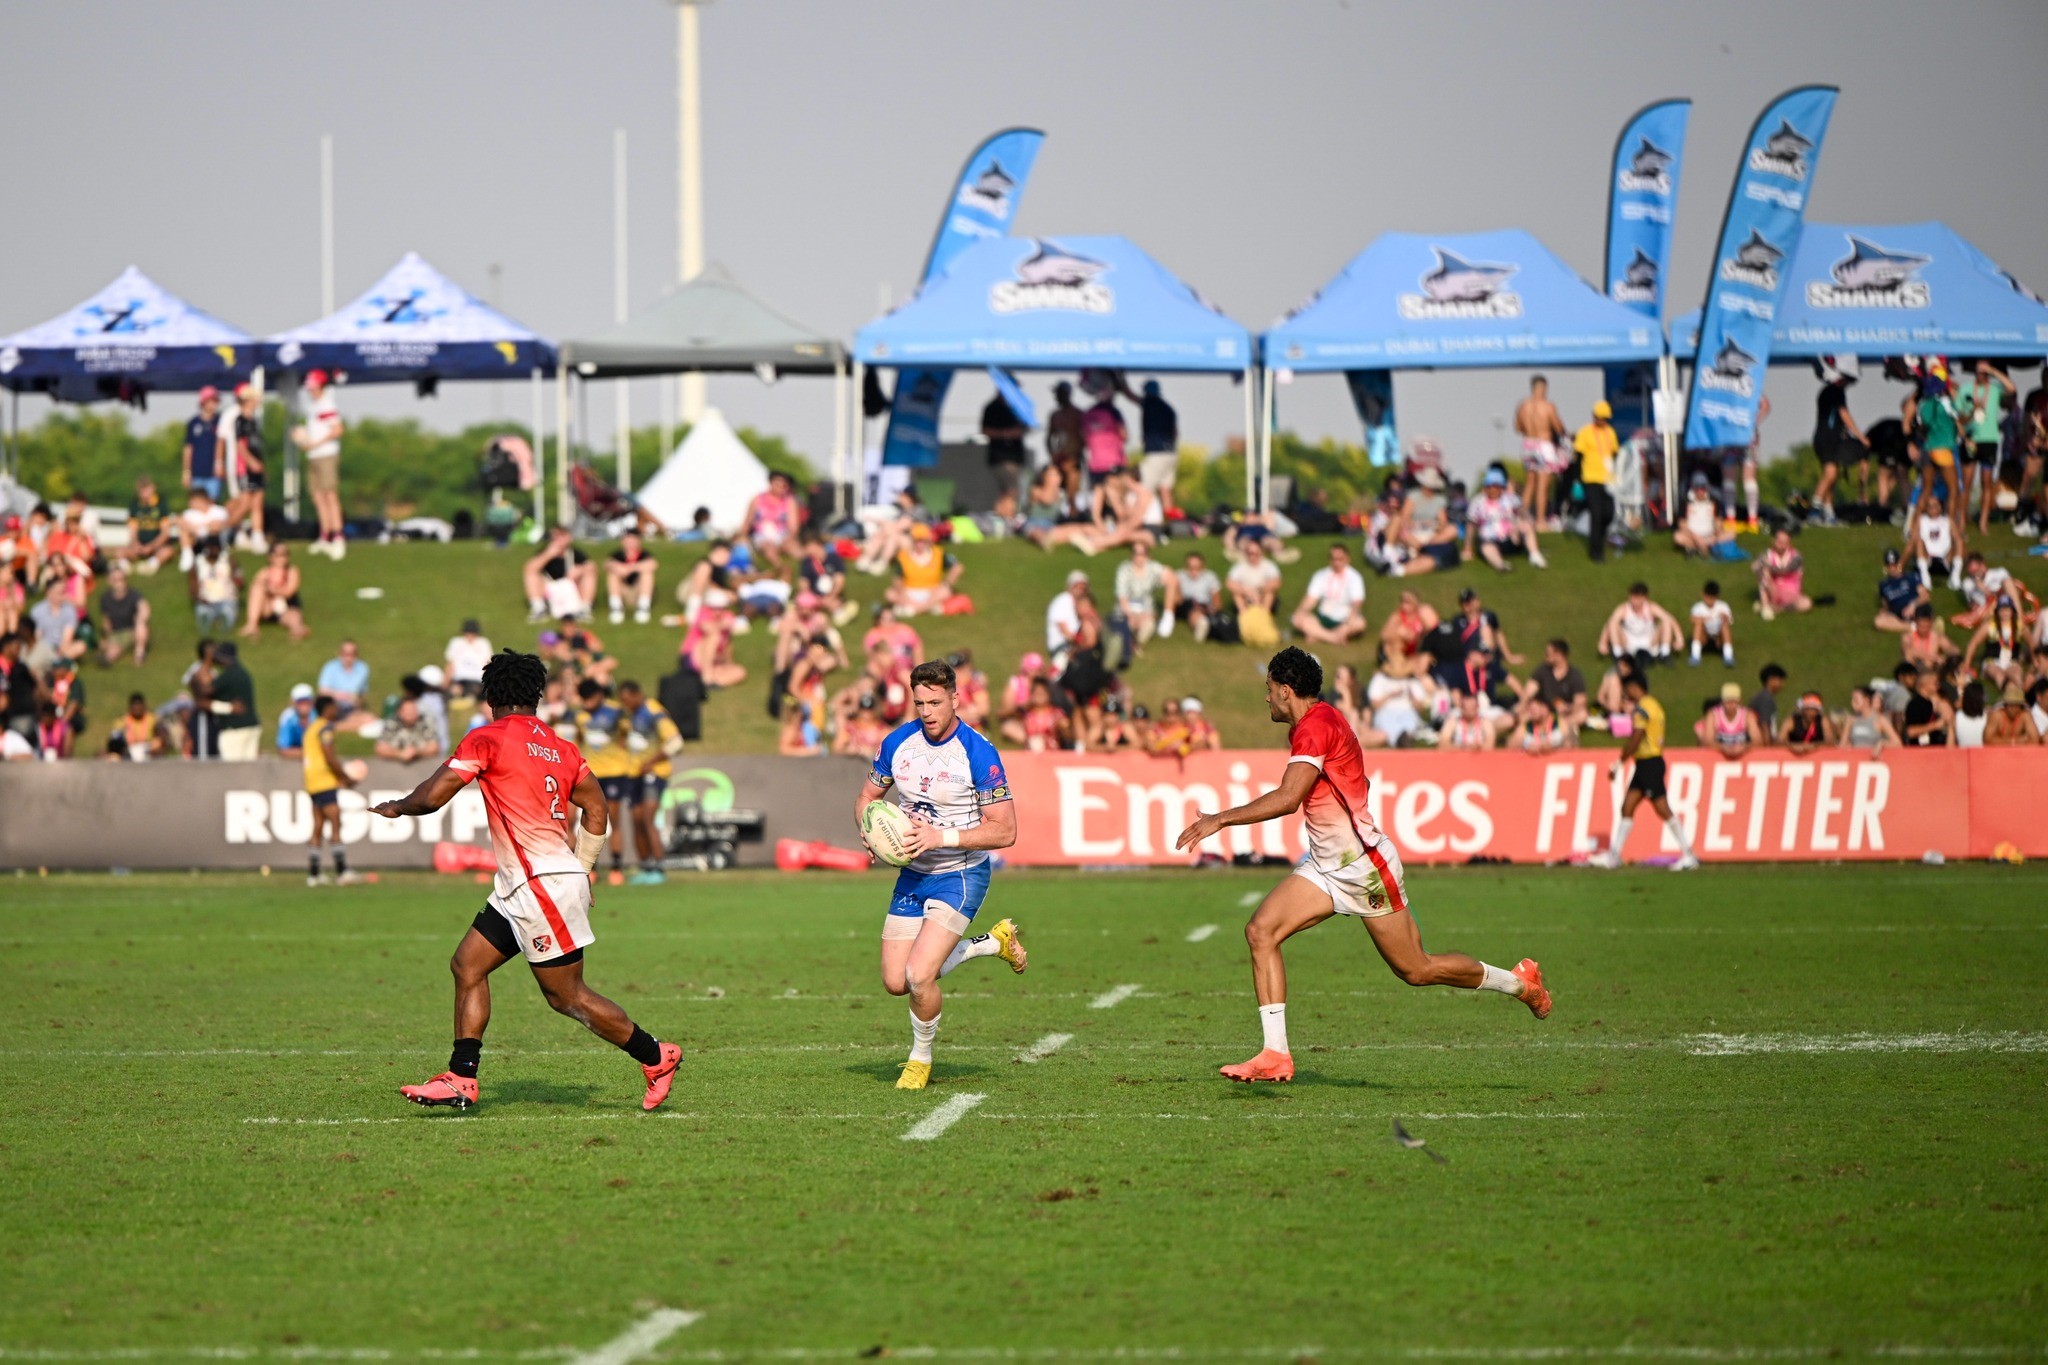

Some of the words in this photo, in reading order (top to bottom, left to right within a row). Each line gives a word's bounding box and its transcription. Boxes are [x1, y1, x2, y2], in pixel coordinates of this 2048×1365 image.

[544, 774, 566, 820] 2
[1054, 761, 1495, 857] Emirtes
[1660, 761, 1891, 851] BETTER
[876, 817, 901, 853] SAMURAI
